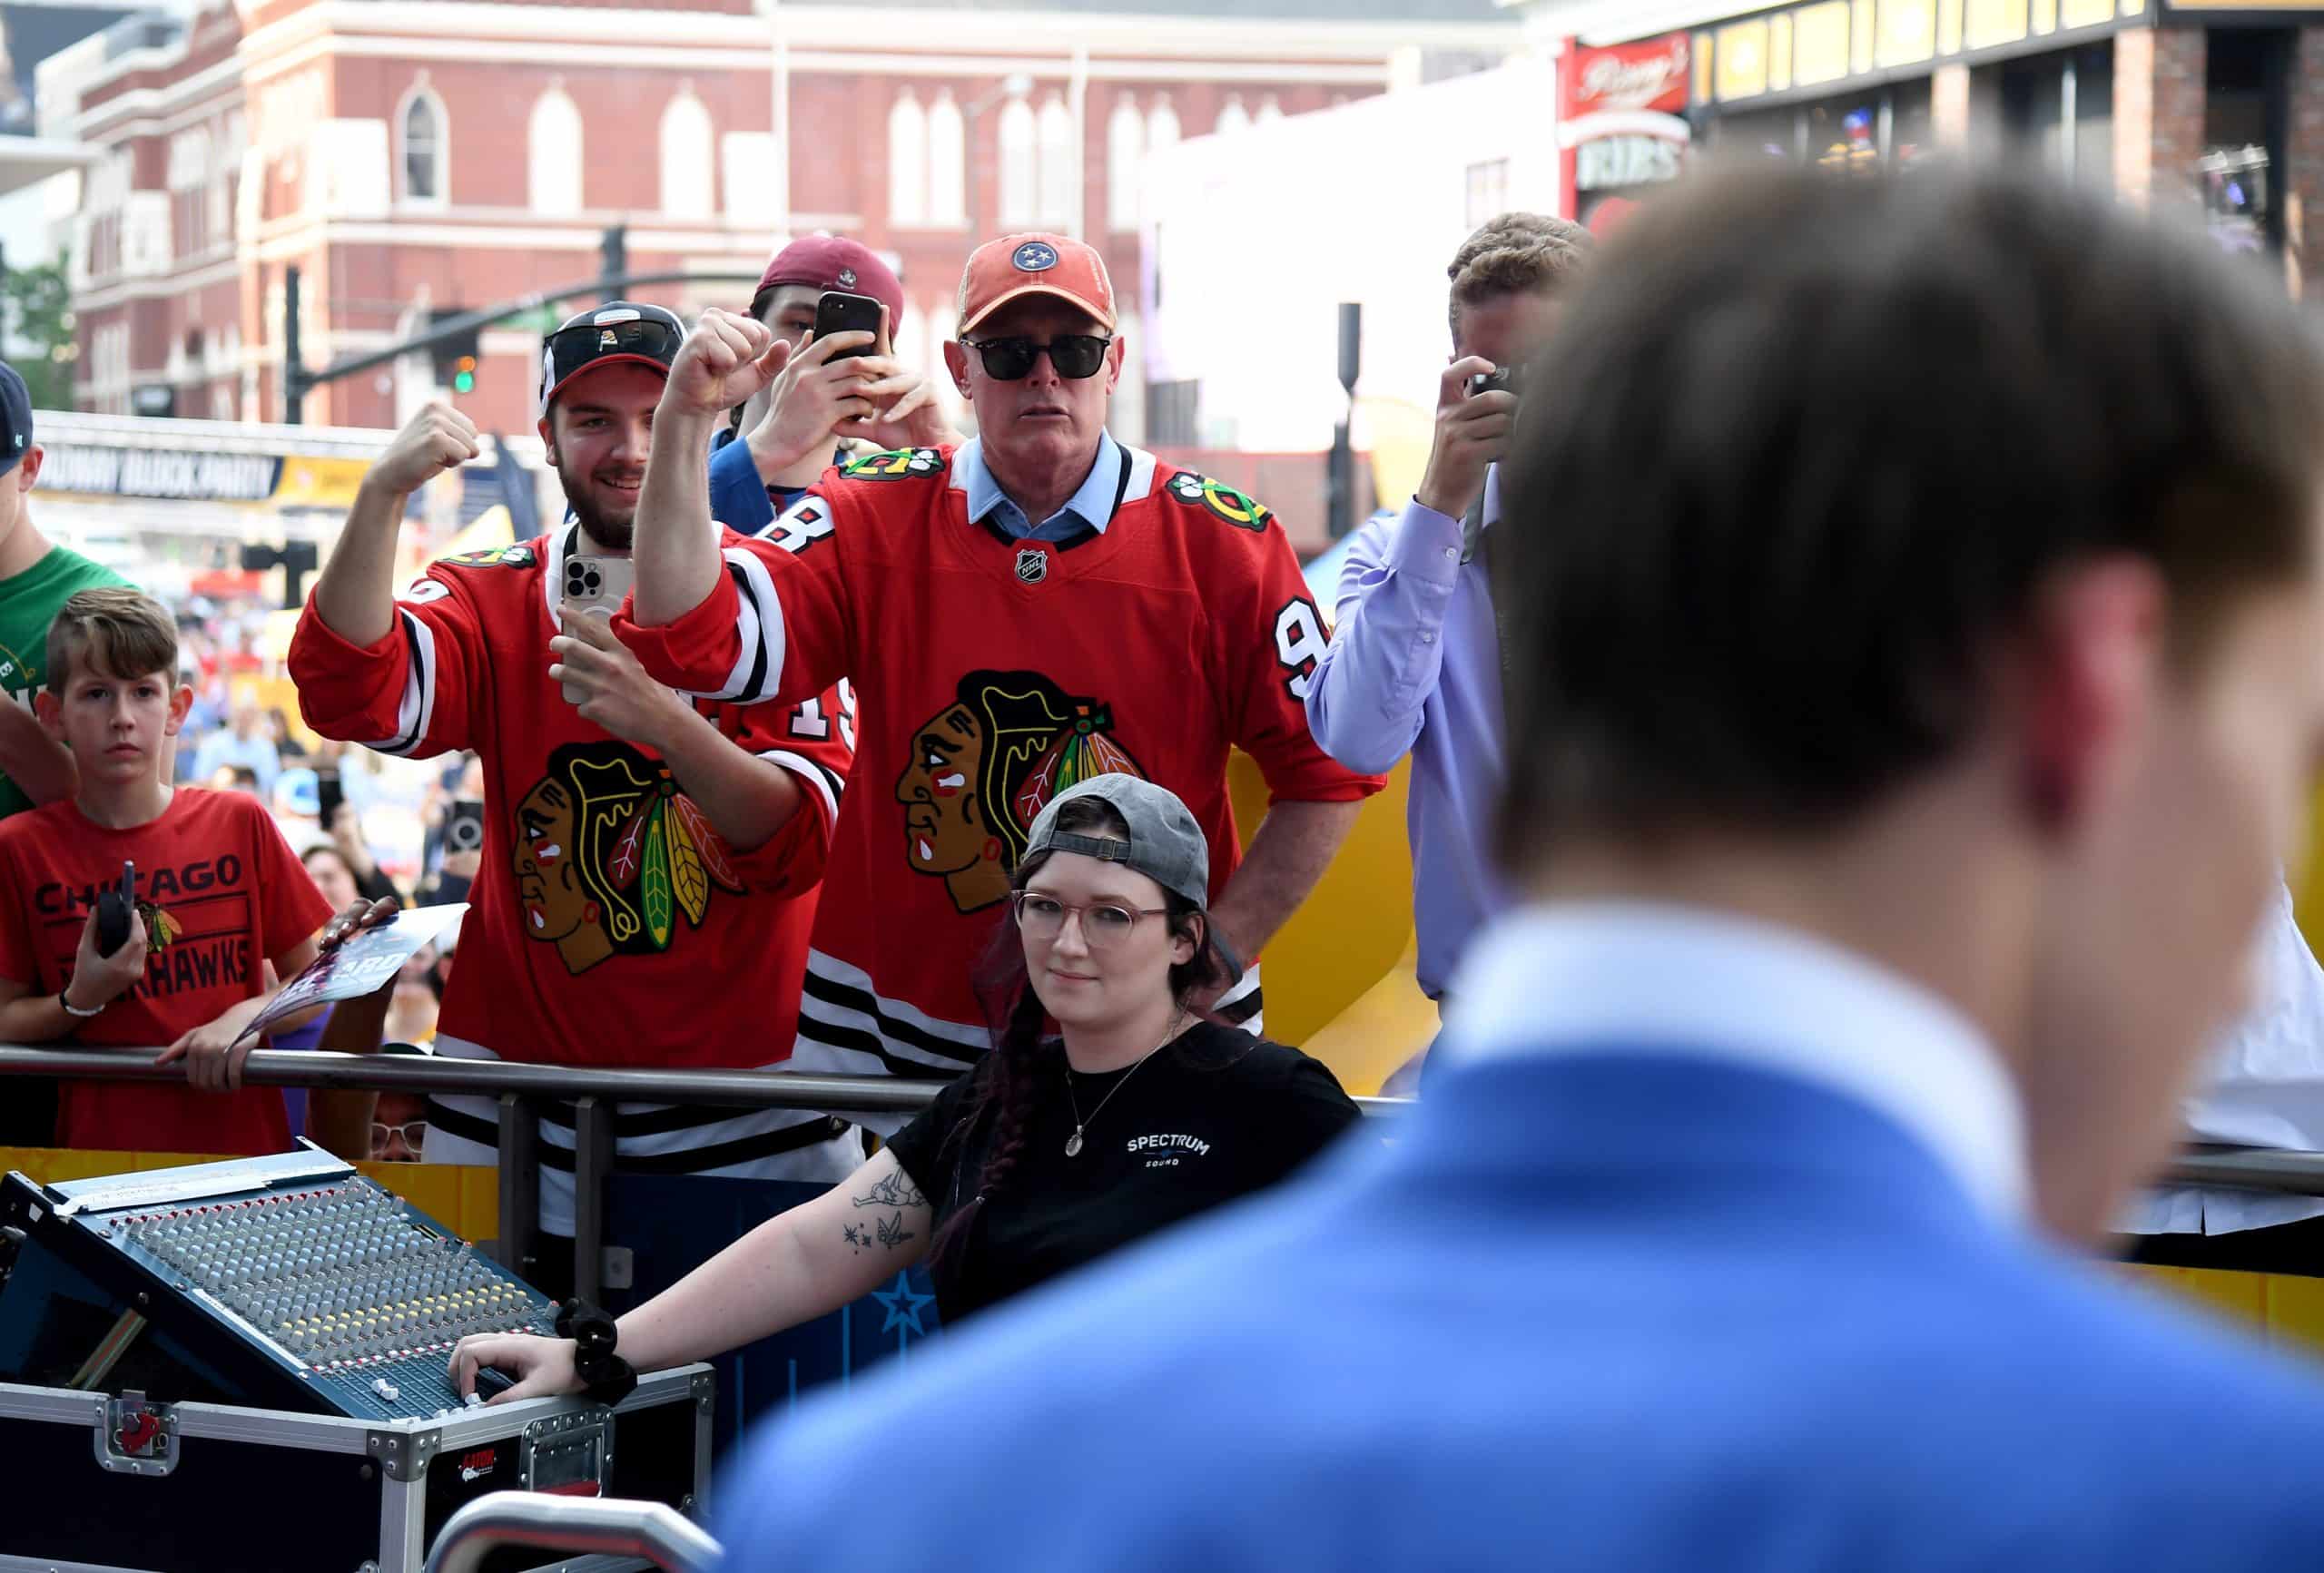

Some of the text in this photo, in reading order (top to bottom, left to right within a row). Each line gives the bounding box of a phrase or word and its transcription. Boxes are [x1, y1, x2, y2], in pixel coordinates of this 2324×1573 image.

[1021, 558, 1041, 575] NHL
[1127, 1134, 1210, 1155] SPECTRUM
[1146, 1158, 1179, 1167] SOUND
